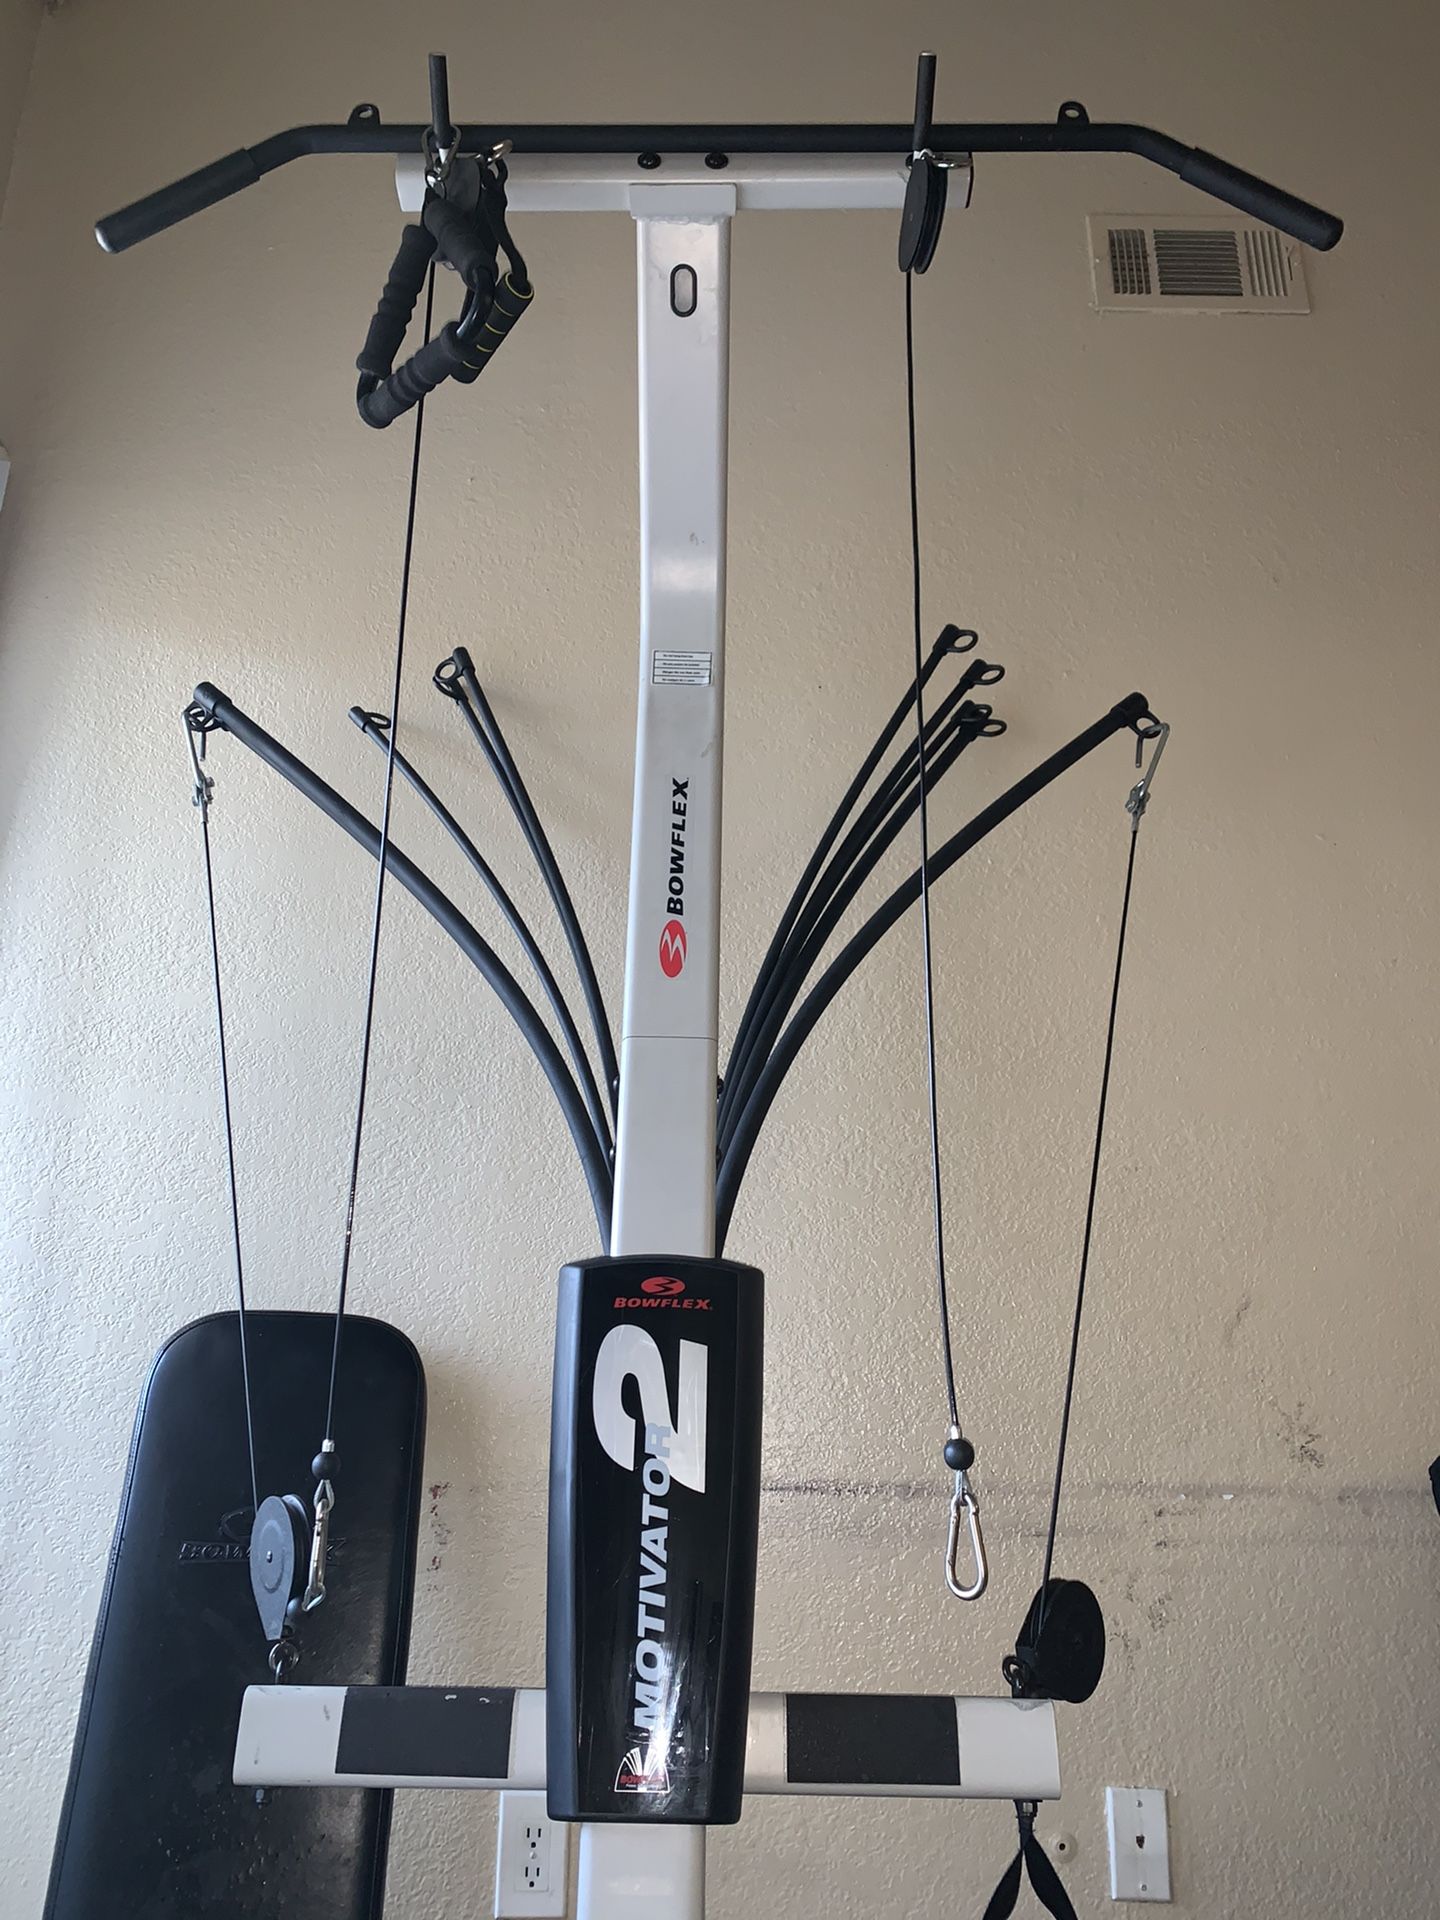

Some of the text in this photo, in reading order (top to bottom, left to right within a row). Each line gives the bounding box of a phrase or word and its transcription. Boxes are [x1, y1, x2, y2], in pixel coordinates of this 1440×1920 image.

[667, 777, 688, 915] BOWFLEX
[614, 1297, 711, 1310] BOWFLEX
[593, 1324, 708, 1493] 2
[634, 1422, 672, 1730] MOTIVATOR
